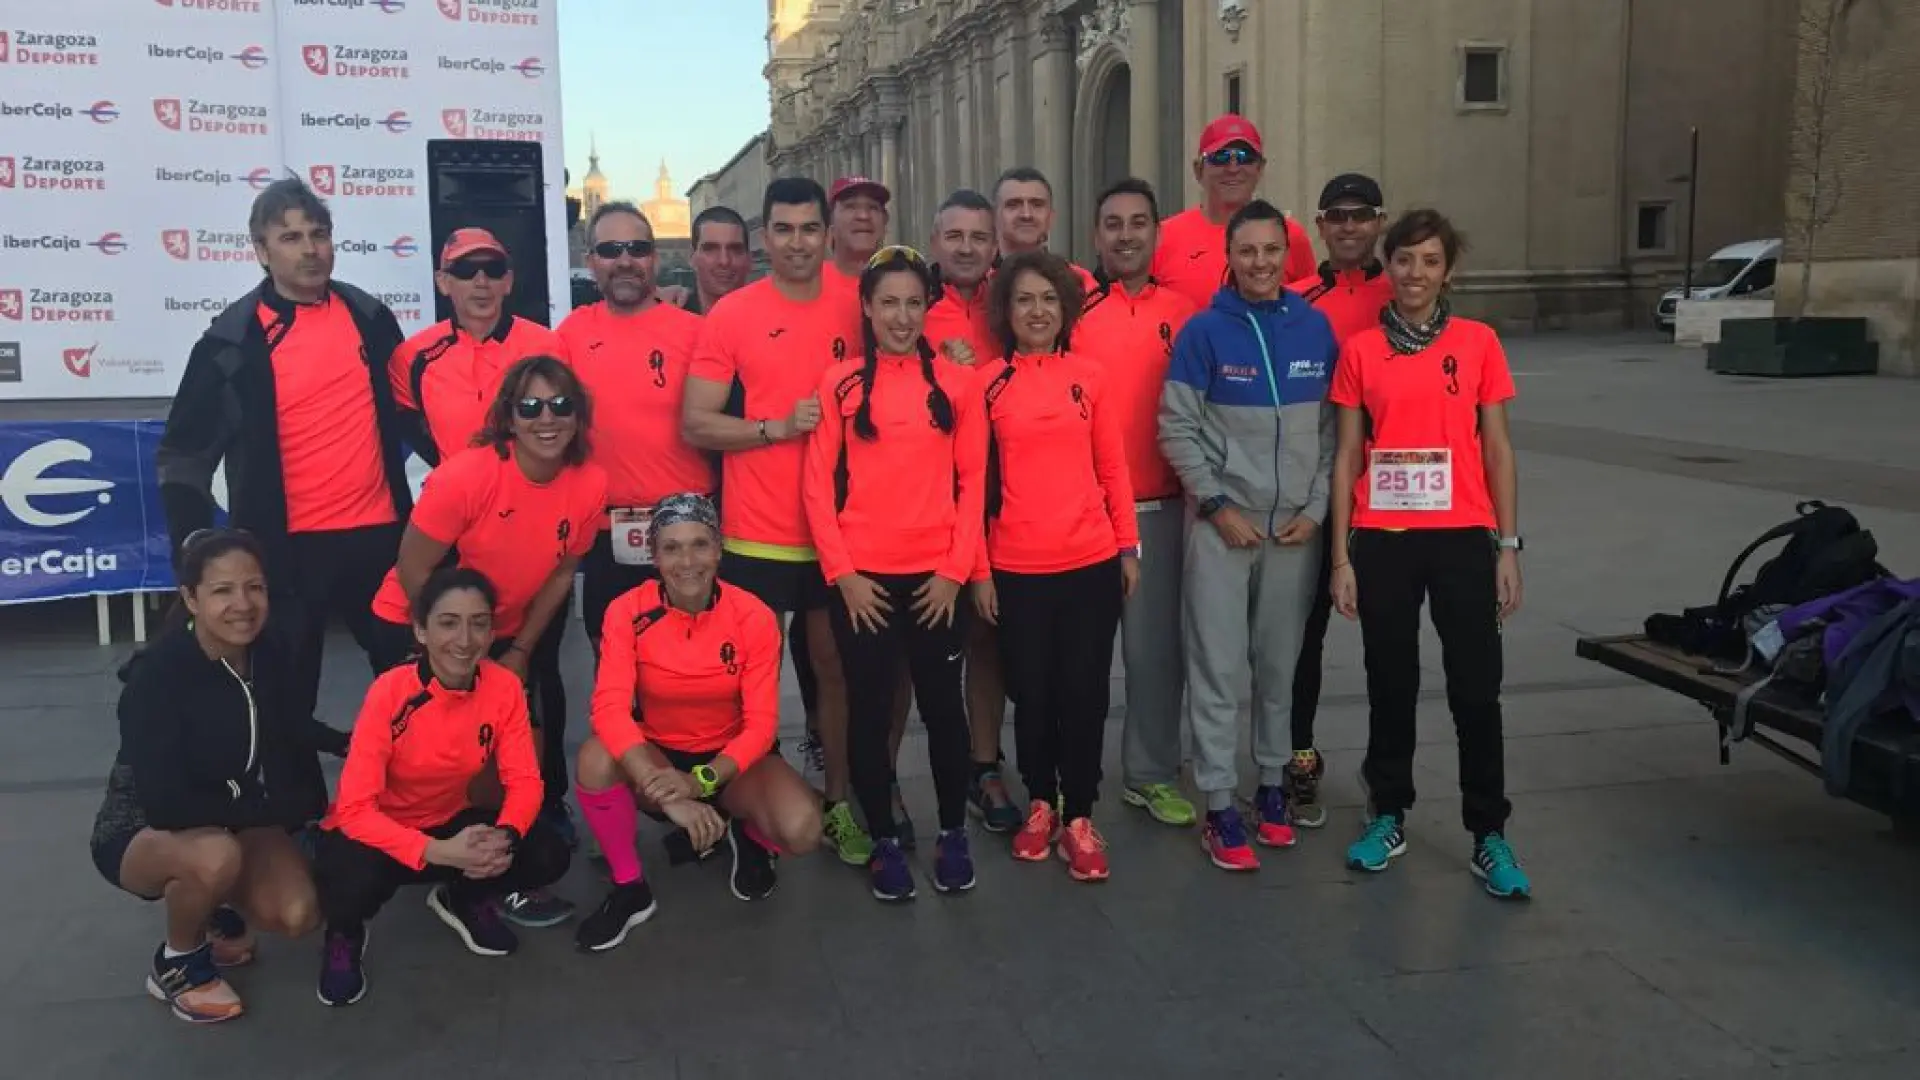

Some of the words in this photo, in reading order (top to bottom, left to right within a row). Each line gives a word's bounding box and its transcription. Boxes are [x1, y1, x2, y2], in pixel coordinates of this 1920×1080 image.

[16, 30, 97, 50] Zaragoza
[17, 49, 98, 65] DEPORTE
[148, 45, 223, 64] iberCaja
[335, 45, 408, 64] Zaragoza
[335, 62, 410, 78] DEPORTE
[438, 56, 505, 75] iberCaja
[1, 101, 73, 120] berCaja
[188, 100, 267, 119] Zaragoza
[472, 108, 543, 127] Zaragoza
[189, 118, 268, 135] DEPORTE
[301, 113, 371, 130] iberCaja
[23, 157, 104, 175] Zaragoza
[341, 165, 414, 182] Zaragoza
[24, 174, 105, 190] DEPORTE
[156, 168, 231, 186] iberCaja
[342, 182, 415, 196] DEPORTE
[3, 235, 80, 252] iberCaja
[335, 240, 377, 255] rCaja
[199, 246, 256, 261] DEPOR
[30, 288, 113, 307] Zaragoza
[32, 306, 114, 321] DEPORTE
[1377, 470, 1445, 491] 2513
[1, 547, 117, 578] erCaja
